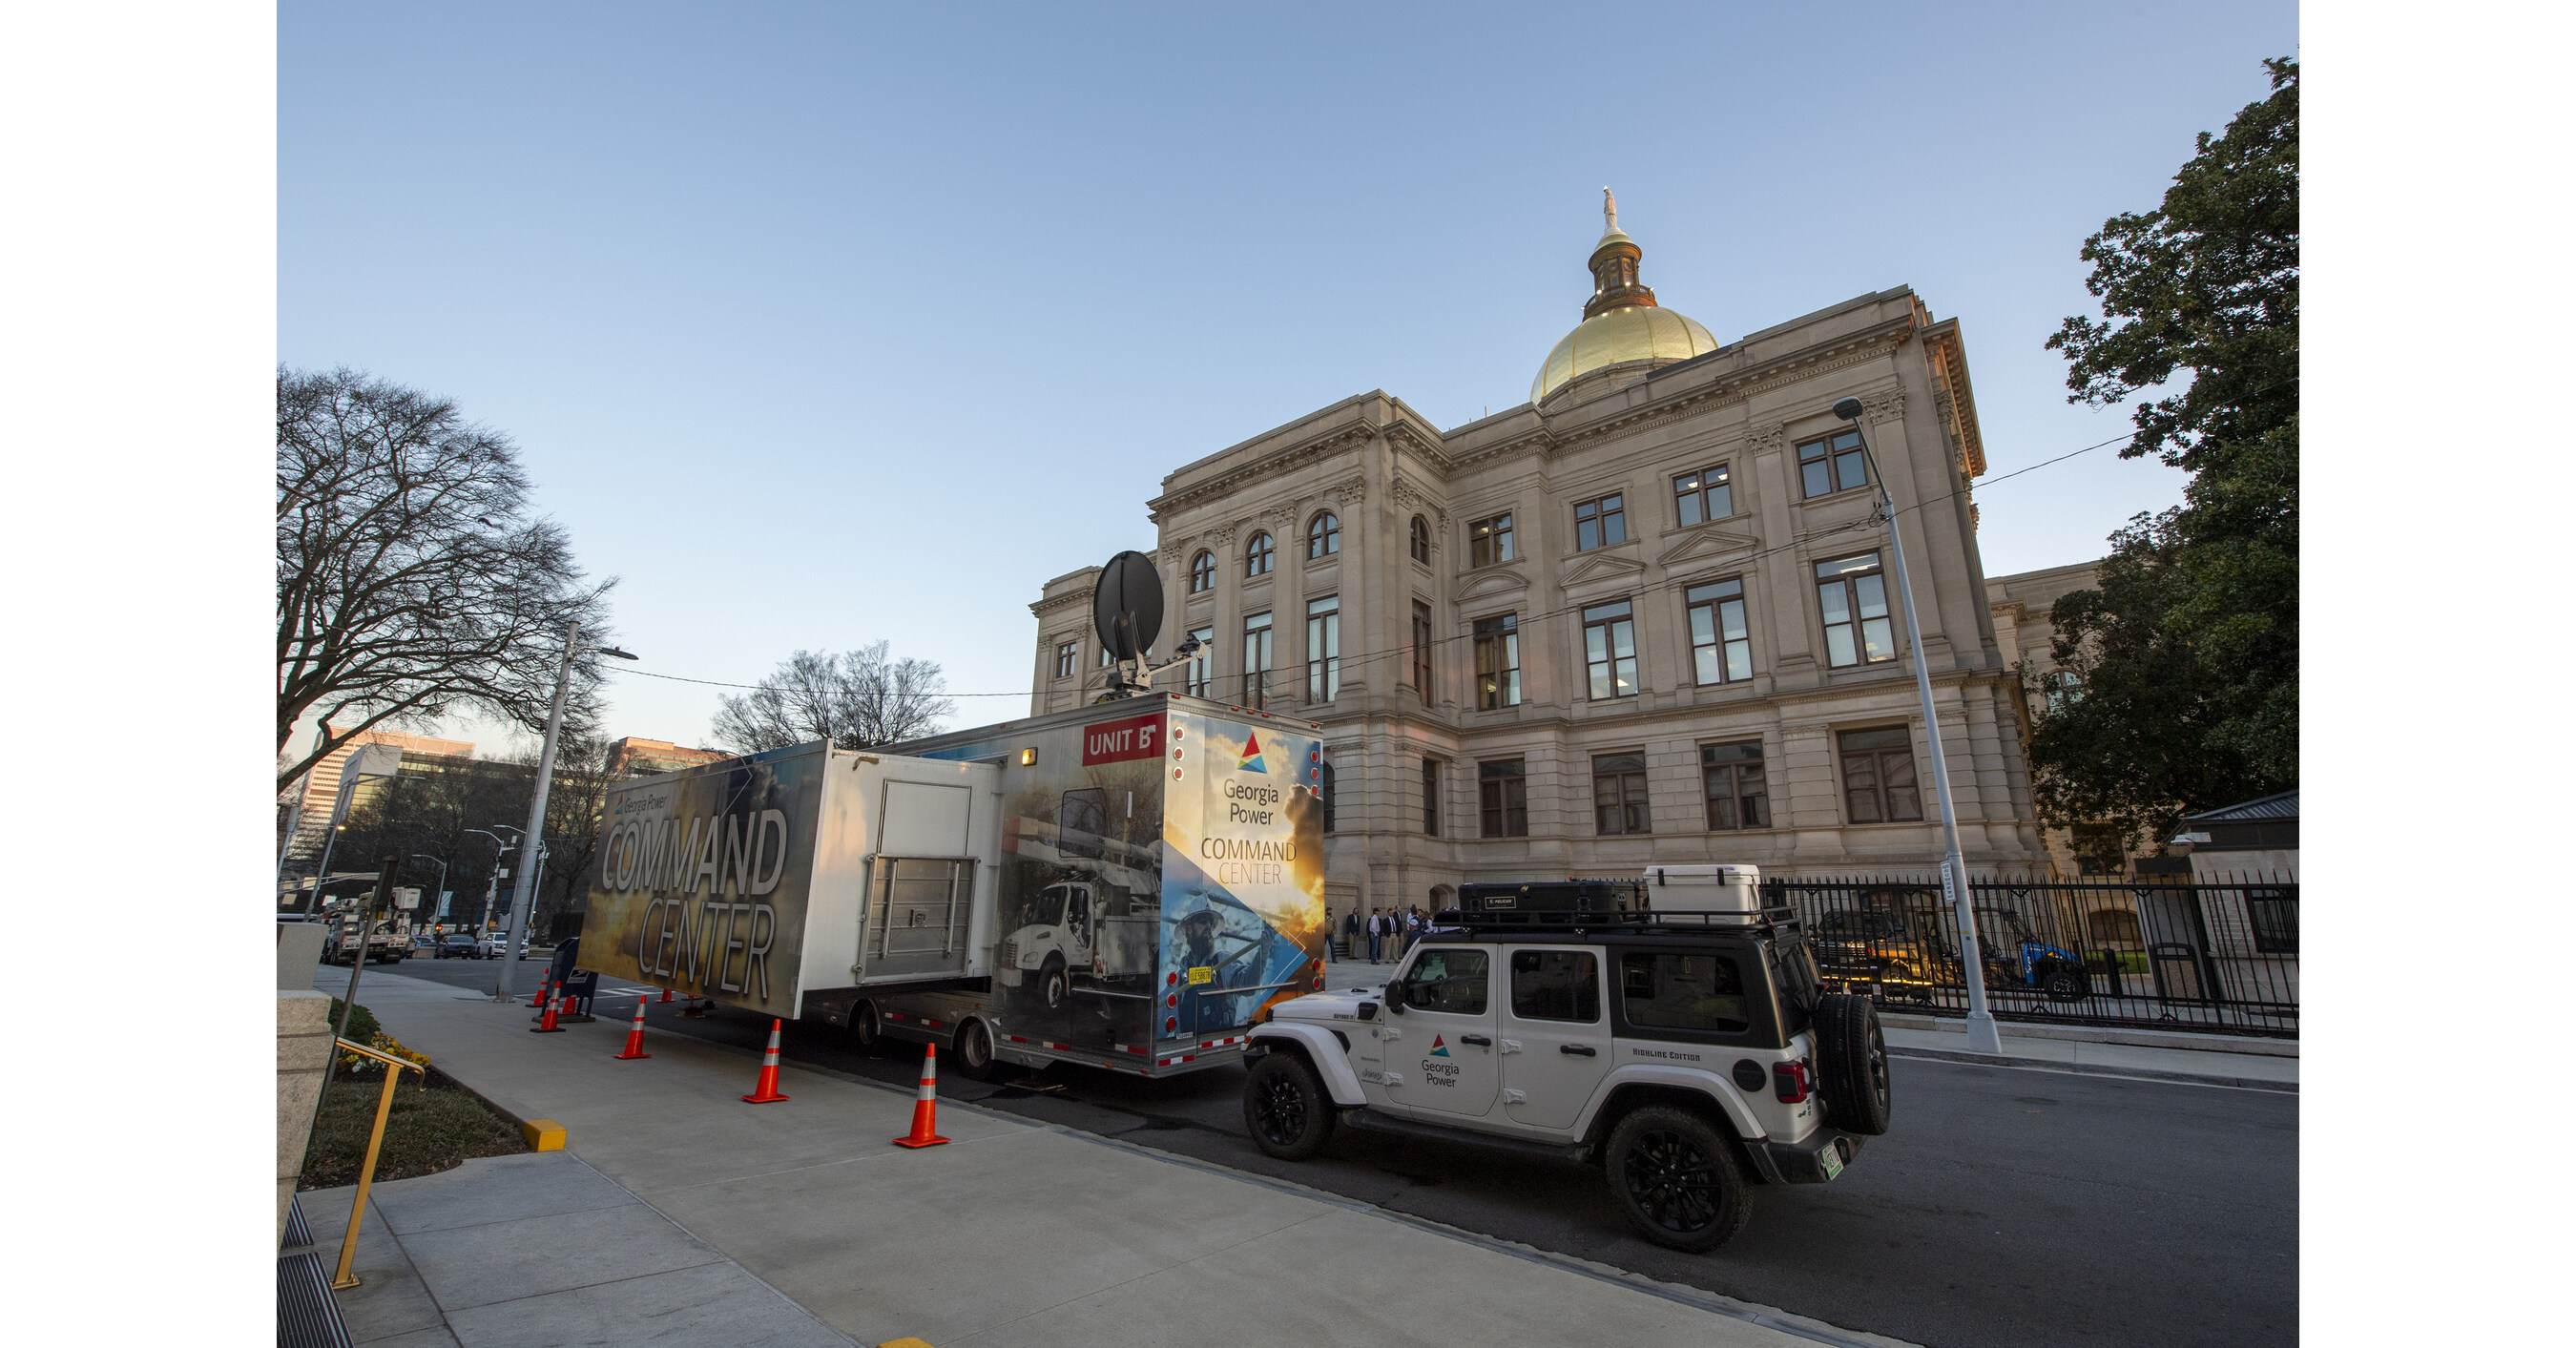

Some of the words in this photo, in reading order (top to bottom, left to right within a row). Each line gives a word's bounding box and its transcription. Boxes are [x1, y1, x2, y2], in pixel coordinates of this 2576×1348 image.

[1091, 729, 1132, 756] UNIT
[1139, 726, 1153, 749] B
[1224, 778, 1278, 806] Georgia
[625, 796, 647, 816] Georgia
[647, 794, 667, 811] Power
[1230, 802, 1274, 825] Power
[602, 808, 787, 895] COMMAND
[1201, 838, 1297, 861] COMMAND
[1219, 862, 1281, 884] CENTER
[639, 897, 776, 999] CENTER
[1362, 1068, 1382, 1081] Jeep
[1422, 1059, 1460, 1076] Georgia
[1426, 1072, 1456, 1088] Power
